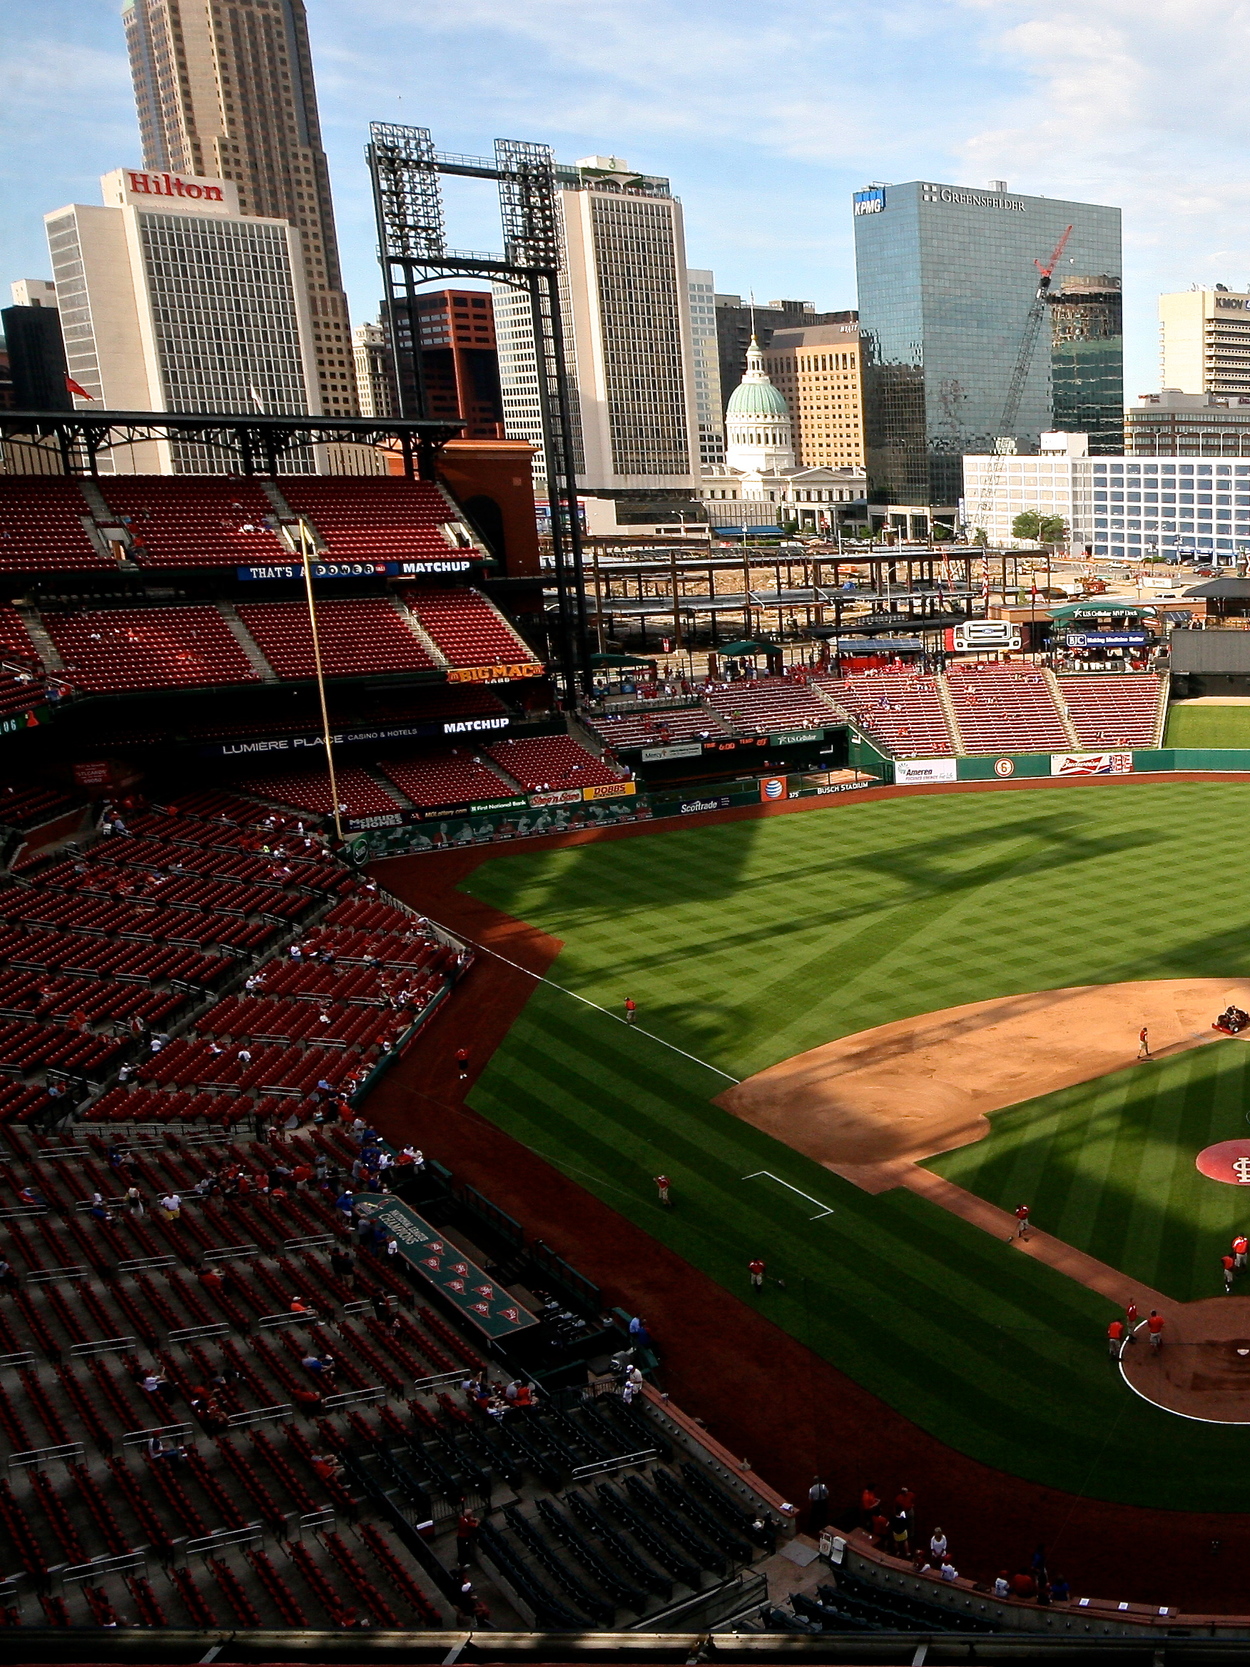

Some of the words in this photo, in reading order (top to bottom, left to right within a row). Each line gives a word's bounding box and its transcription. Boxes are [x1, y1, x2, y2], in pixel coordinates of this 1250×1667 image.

[128, 172, 224, 201] Hilton
[940, 188, 1027, 212] GREENSFELDER
[854, 198, 882, 216] KPMG
[1215, 297, 1243, 310] KMOV
[250, 566, 293, 579] THAT'S
[316, 564, 375, 577] POWER
[402, 561, 471, 574] MATCHUP
[1069, 634, 1085, 646] BJC
[460, 668, 489, 683] BIG
[492, 664, 534, 678] MAC
[484, 677, 511, 685] LAND
[444, 717, 510, 734] MATCHUP
[293, 734, 345, 748] PLACE
[347, 732, 378, 741] CASINO
[387, 728, 418, 737] HOTELS
[718, 742, 735, 751] 6:00
[645, 750, 663, 760] Mercy
[1060, 757, 1101, 769] Budweiser
[905, 768, 933, 776] Ameren
[593, 783, 627, 796] DOBBS
[817, 785, 839, 795] BUSCH
[840, 781, 868, 792] STADIUM
[512, 800, 526, 808] Bank
[681, 800, 718, 814] Scottrade
[349, 813, 401, 826] McBRIDE
[360, 819, 403, 830] HOMES
[378, 1213, 419, 1245] CHAMPIONS
